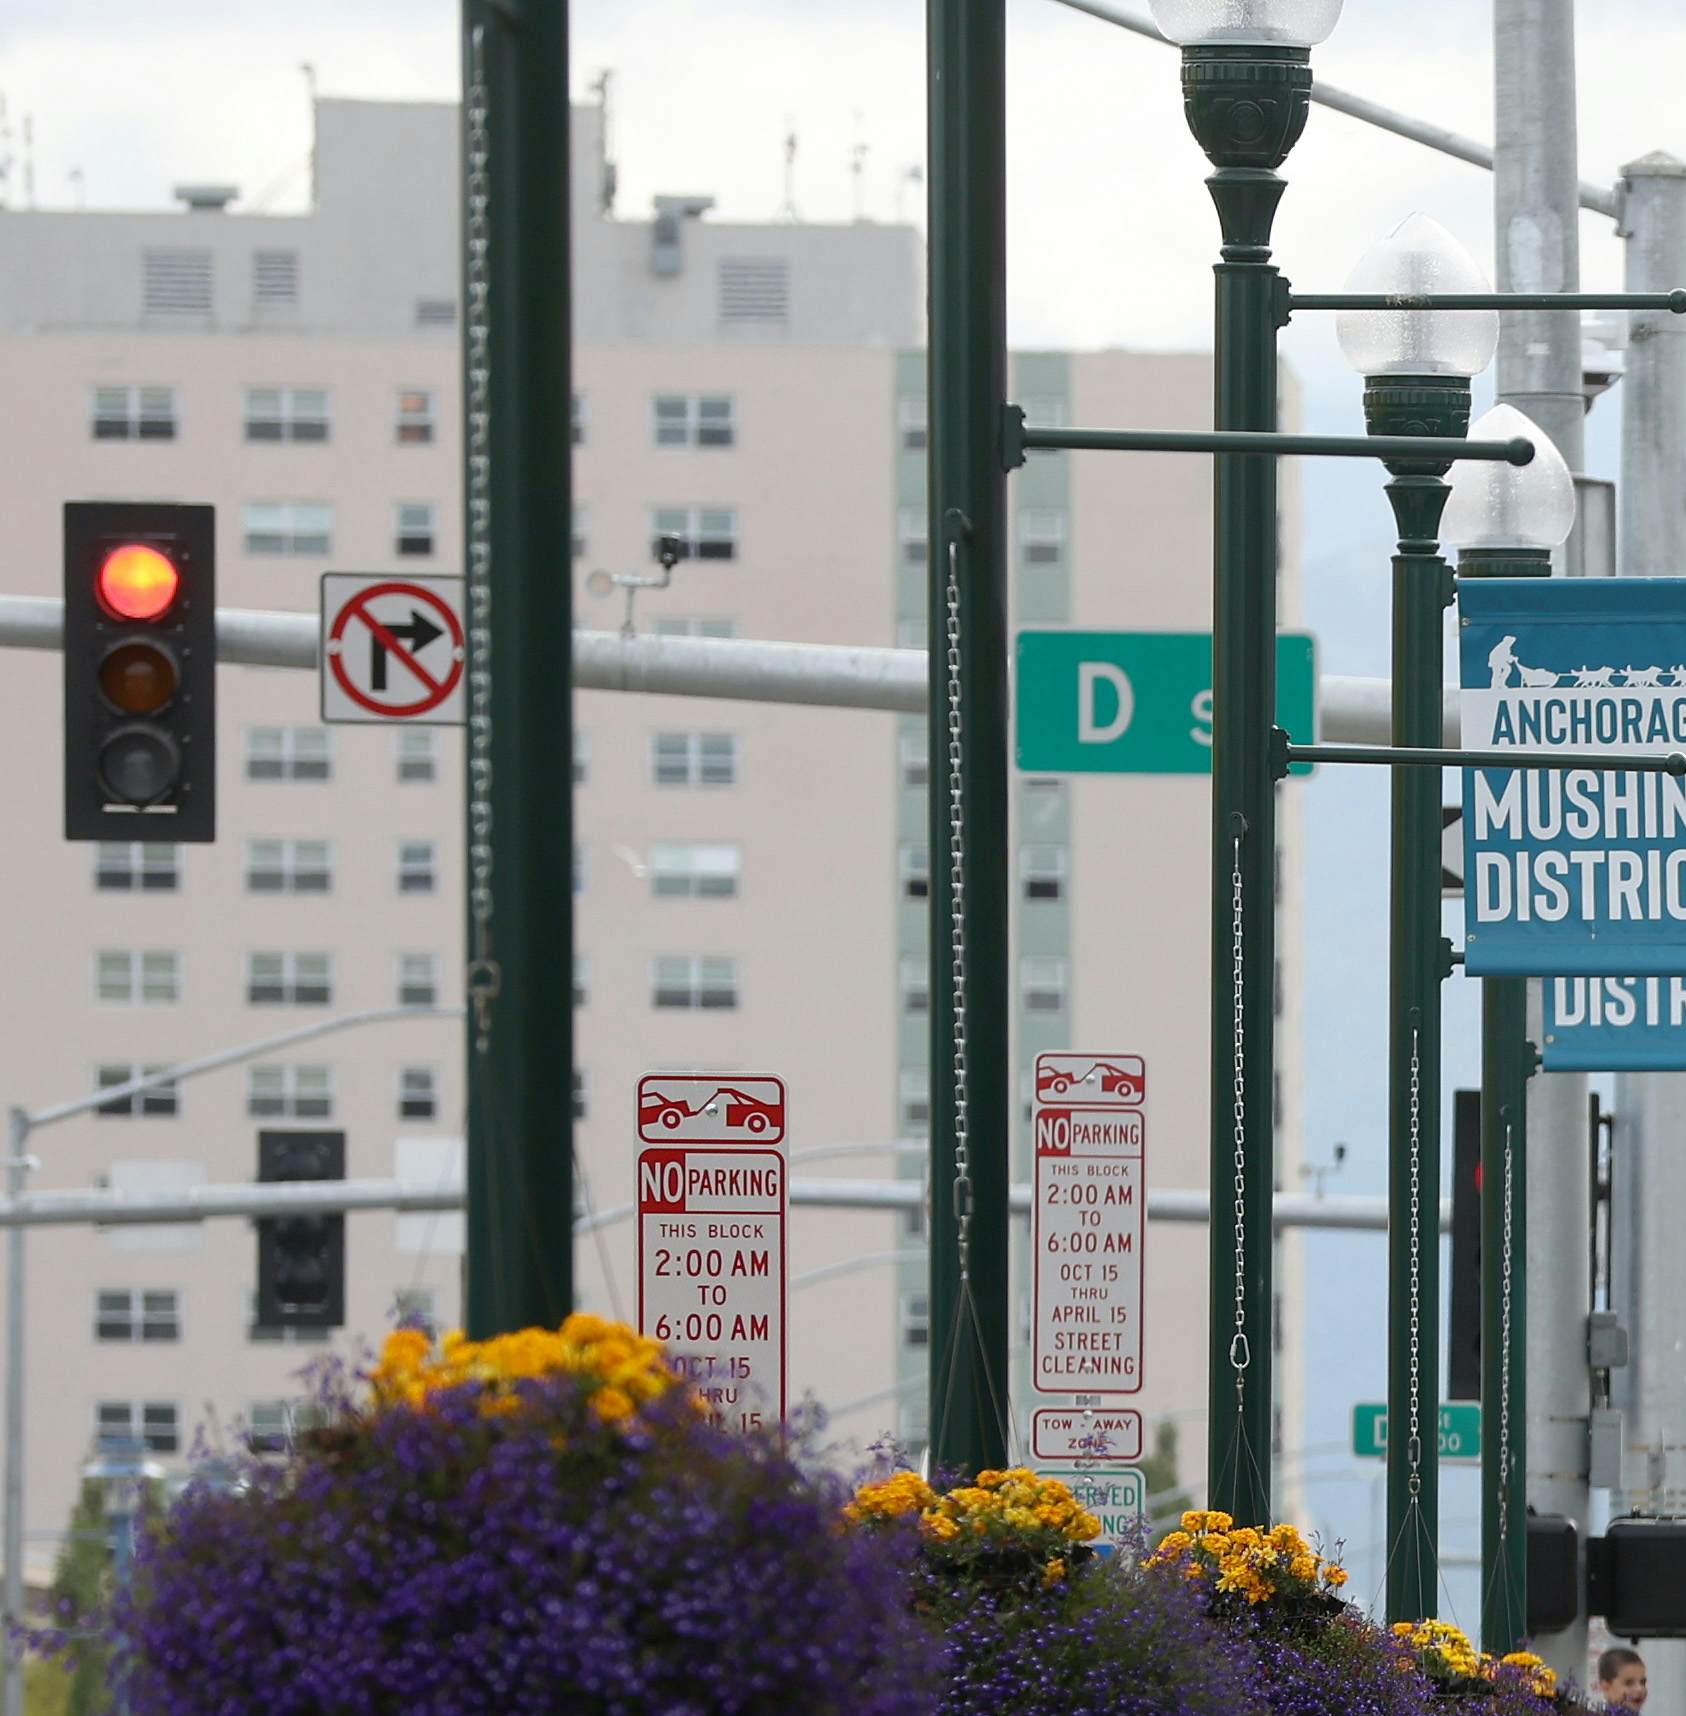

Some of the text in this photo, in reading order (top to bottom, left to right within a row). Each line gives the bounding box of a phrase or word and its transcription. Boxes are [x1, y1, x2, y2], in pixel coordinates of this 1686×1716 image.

[1077, 661, 1213, 746] D S
[1039, 1117, 1139, 1150] NO PARKING
[1052, 1164, 1128, 1177] THIS BLOCK
[641, 1160, 777, 1203] NO PARKING
[1047, 1183, 1132, 1205] 2:00 AM
[1080, 1210, 1101, 1227] TO
[660, 1223, 764, 1239] THIS BLOCK
[1047, 1232, 1132, 1253] 6:00 AM
[655, 1249, 769, 1277] 2:00 AM
[1060, 1263, 1118, 1281] OCT 15
[697, 1284, 727, 1306] TO
[1071, 1287, 1108, 1300] THRU
[1051, 1306, 1127, 1324] APRIL 15
[655, 1314, 769, 1341] 6:00 AM
[1055, 1332, 1123, 1351] STREET
[729, 1357, 750, 1379] 15
[1042, 1355, 1134, 1375] CLEANING
[699, 1387, 738, 1404] HRU
[1042, 1418, 1072, 1430] TOW
[1093, 1418, 1132, 1430] AWAY
